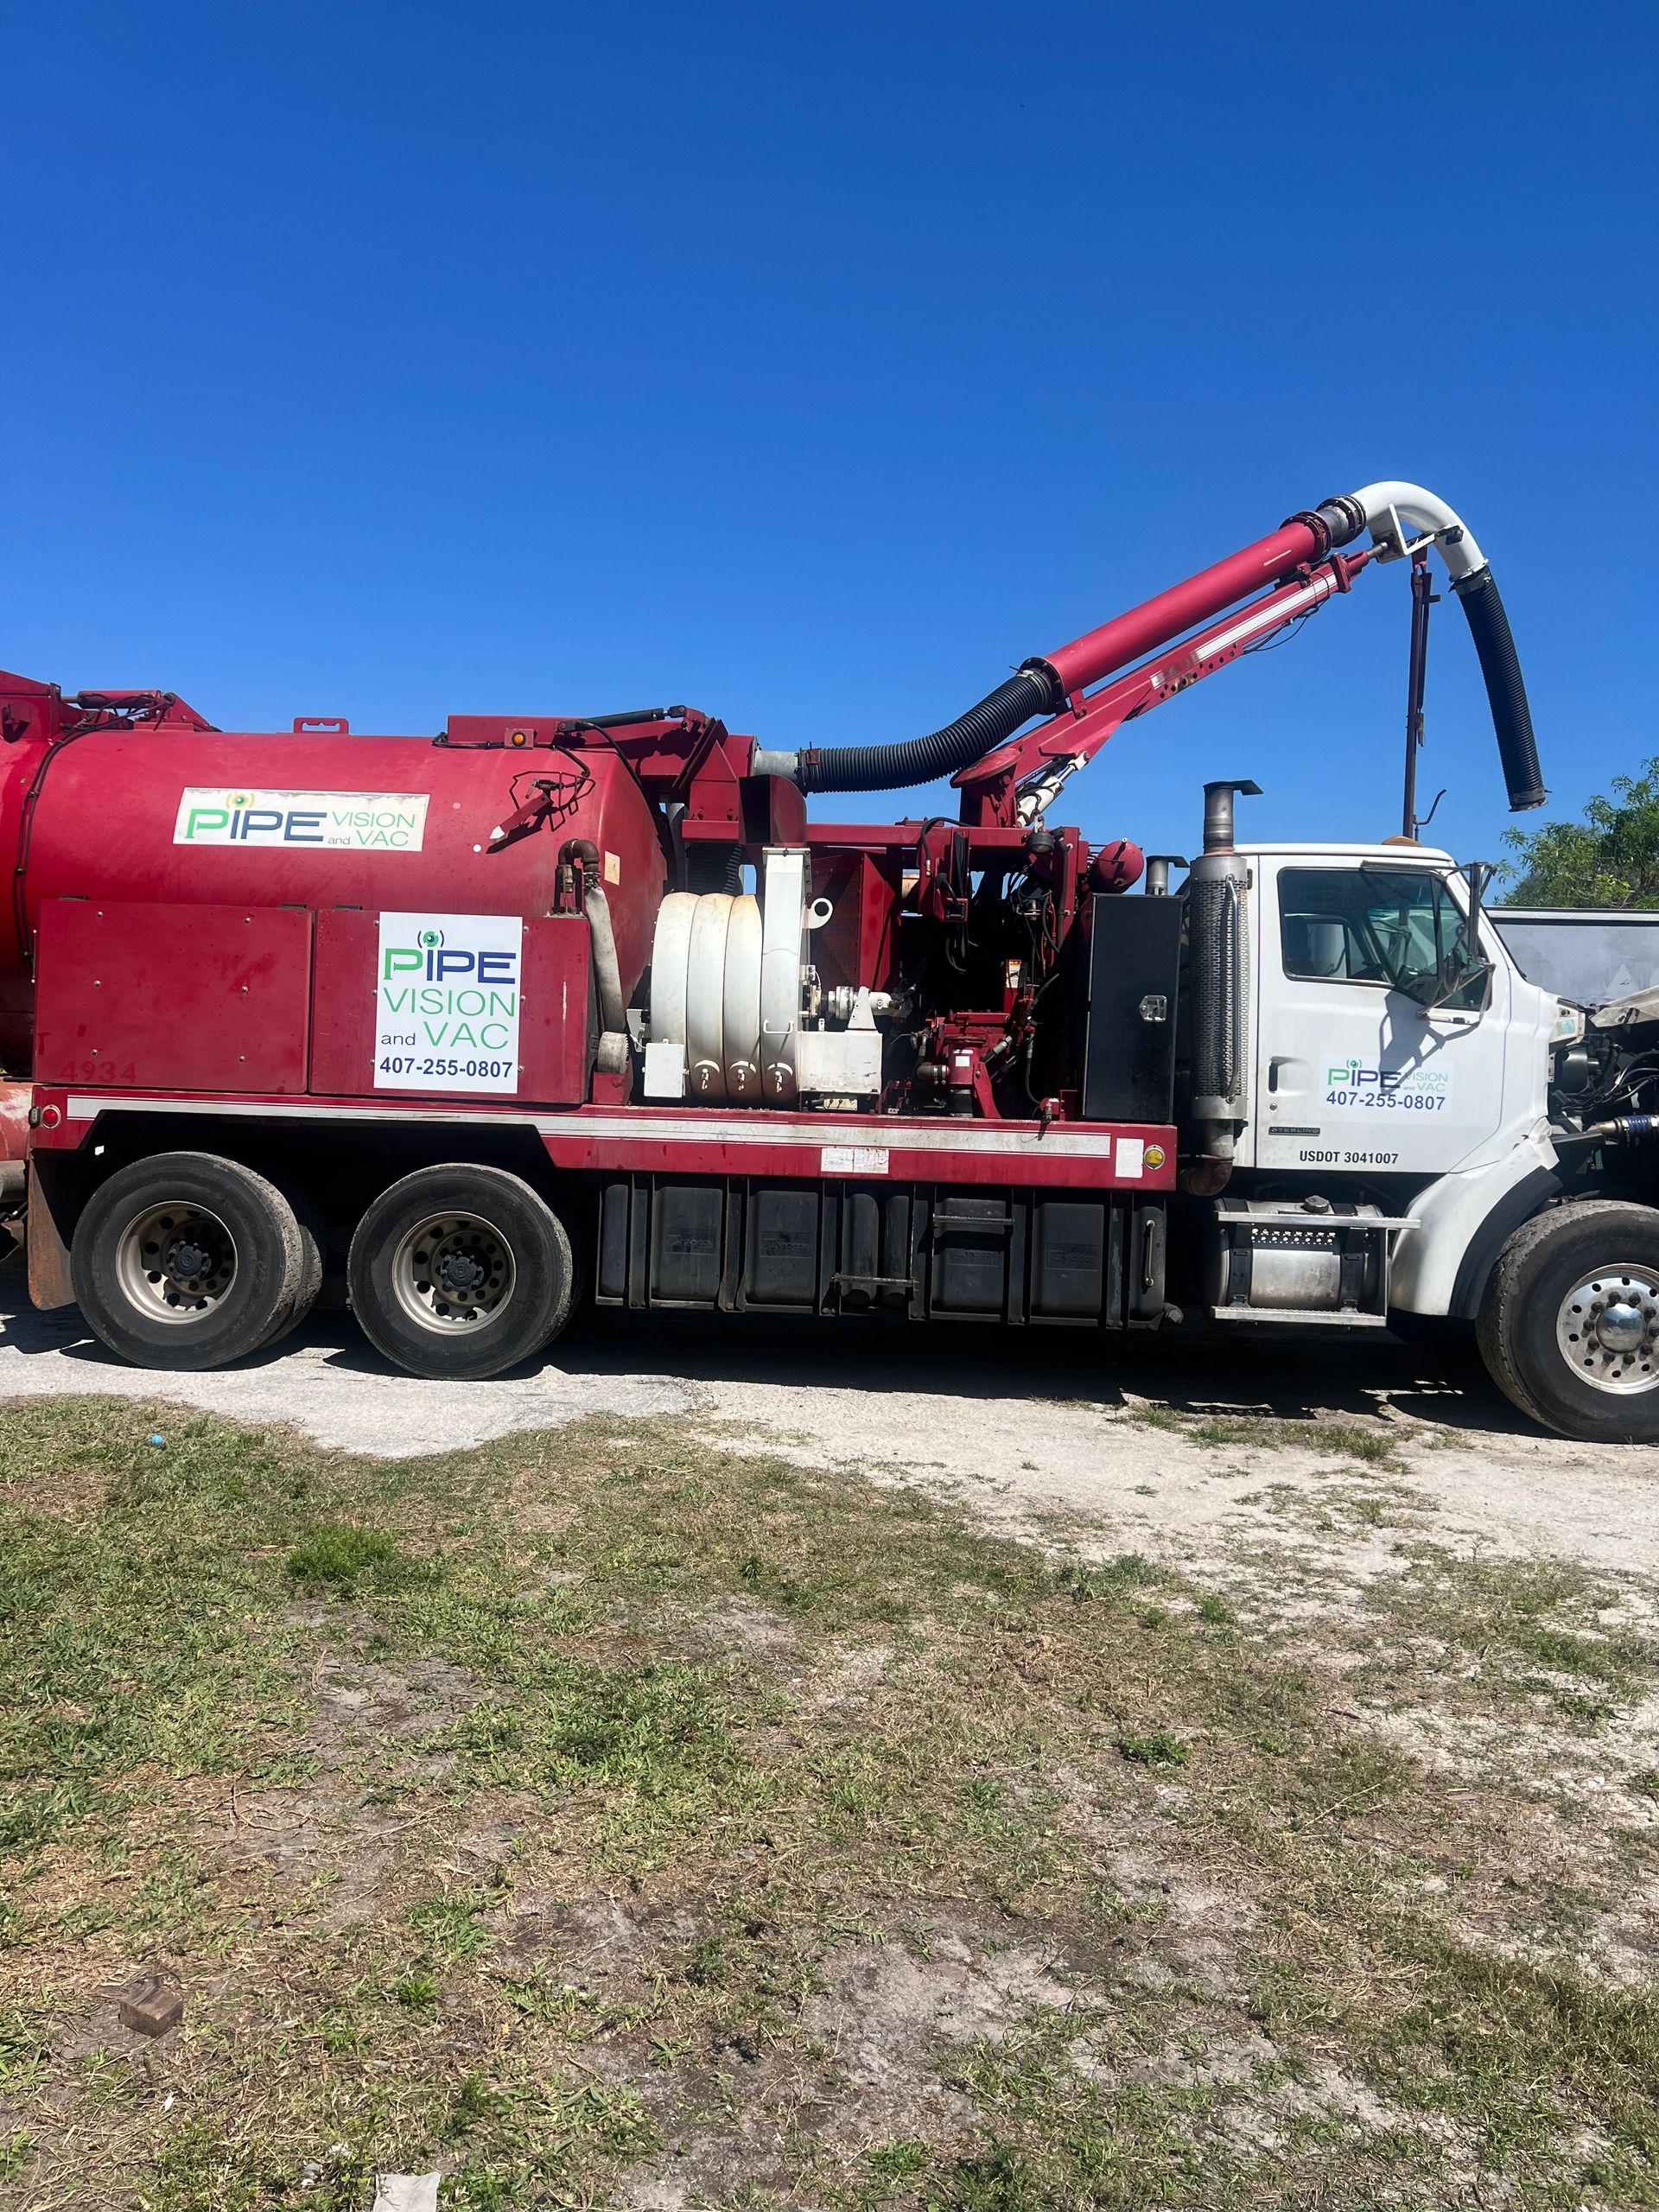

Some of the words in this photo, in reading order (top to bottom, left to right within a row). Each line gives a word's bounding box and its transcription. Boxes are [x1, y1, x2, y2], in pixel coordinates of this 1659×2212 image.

[185, 808, 327, 842] PIPE
[332, 810, 416, 829] VISION
[327, 835, 351, 846] and
[356, 830, 409, 847] VAC
[383, 947, 517, 984] PIPE
[383, 987, 516, 1018] VISION
[380, 1032, 416, 1046] and
[423, 1020, 509, 1050] VAC
[60, 1059, 137, 1084] 4934
[379, 1056, 513, 1078] 407-255-0807
[1326, 1067, 1402, 1089] PIPE
[1403, 1071, 1448, 1083] VISION
[1417, 1082, 1446, 1093] VAC
[1325, 1090, 1446, 1111] 407-255-0807
[1299, 1150, 1341, 1162] USDOT
[1344, 1152, 1400, 1165] 3041007
